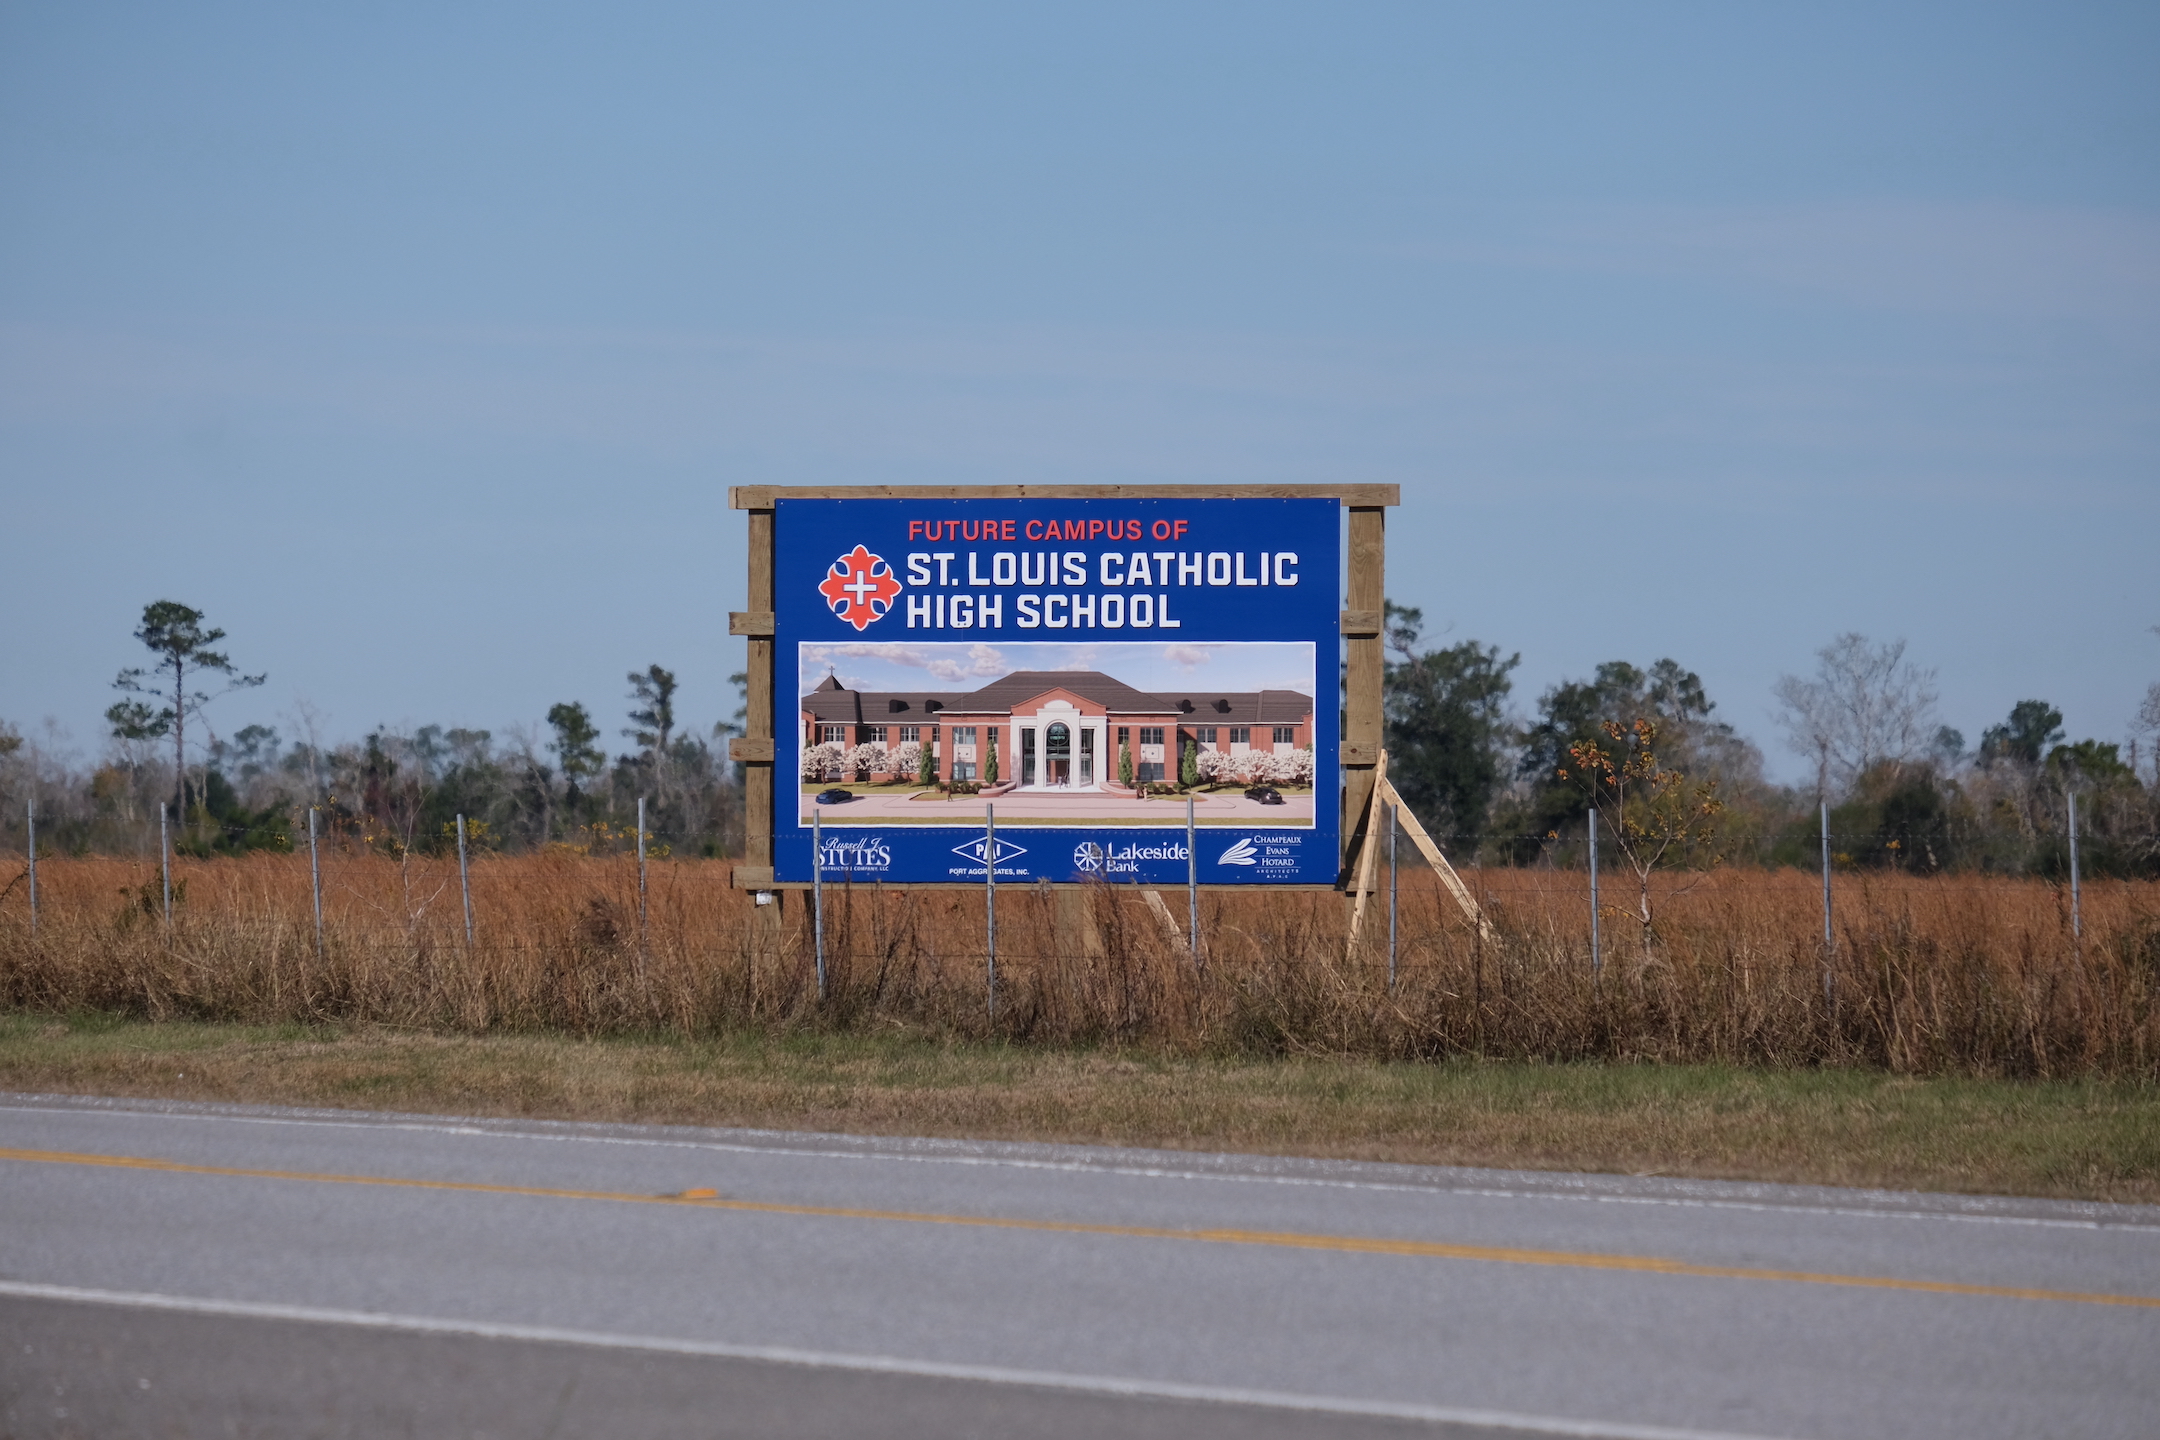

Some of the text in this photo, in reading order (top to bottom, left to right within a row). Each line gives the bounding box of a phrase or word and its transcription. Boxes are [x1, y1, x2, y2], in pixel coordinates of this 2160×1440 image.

[908, 519, 1189, 541] FUTURE CAMPUS OF
[907, 552, 1299, 586] ST. LOUIS CATHOLIC
[907, 594, 1181, 628] HIGH SCHOOL
[825, 837, 868, 850] Russell
[1106, 841, 1189, 860] Lakeside
[968, 868, 1015, 876] AGGRGATES,
[1016, 868, 1030, 876] INC.
[1106, 860, 1139, 872] Bank
